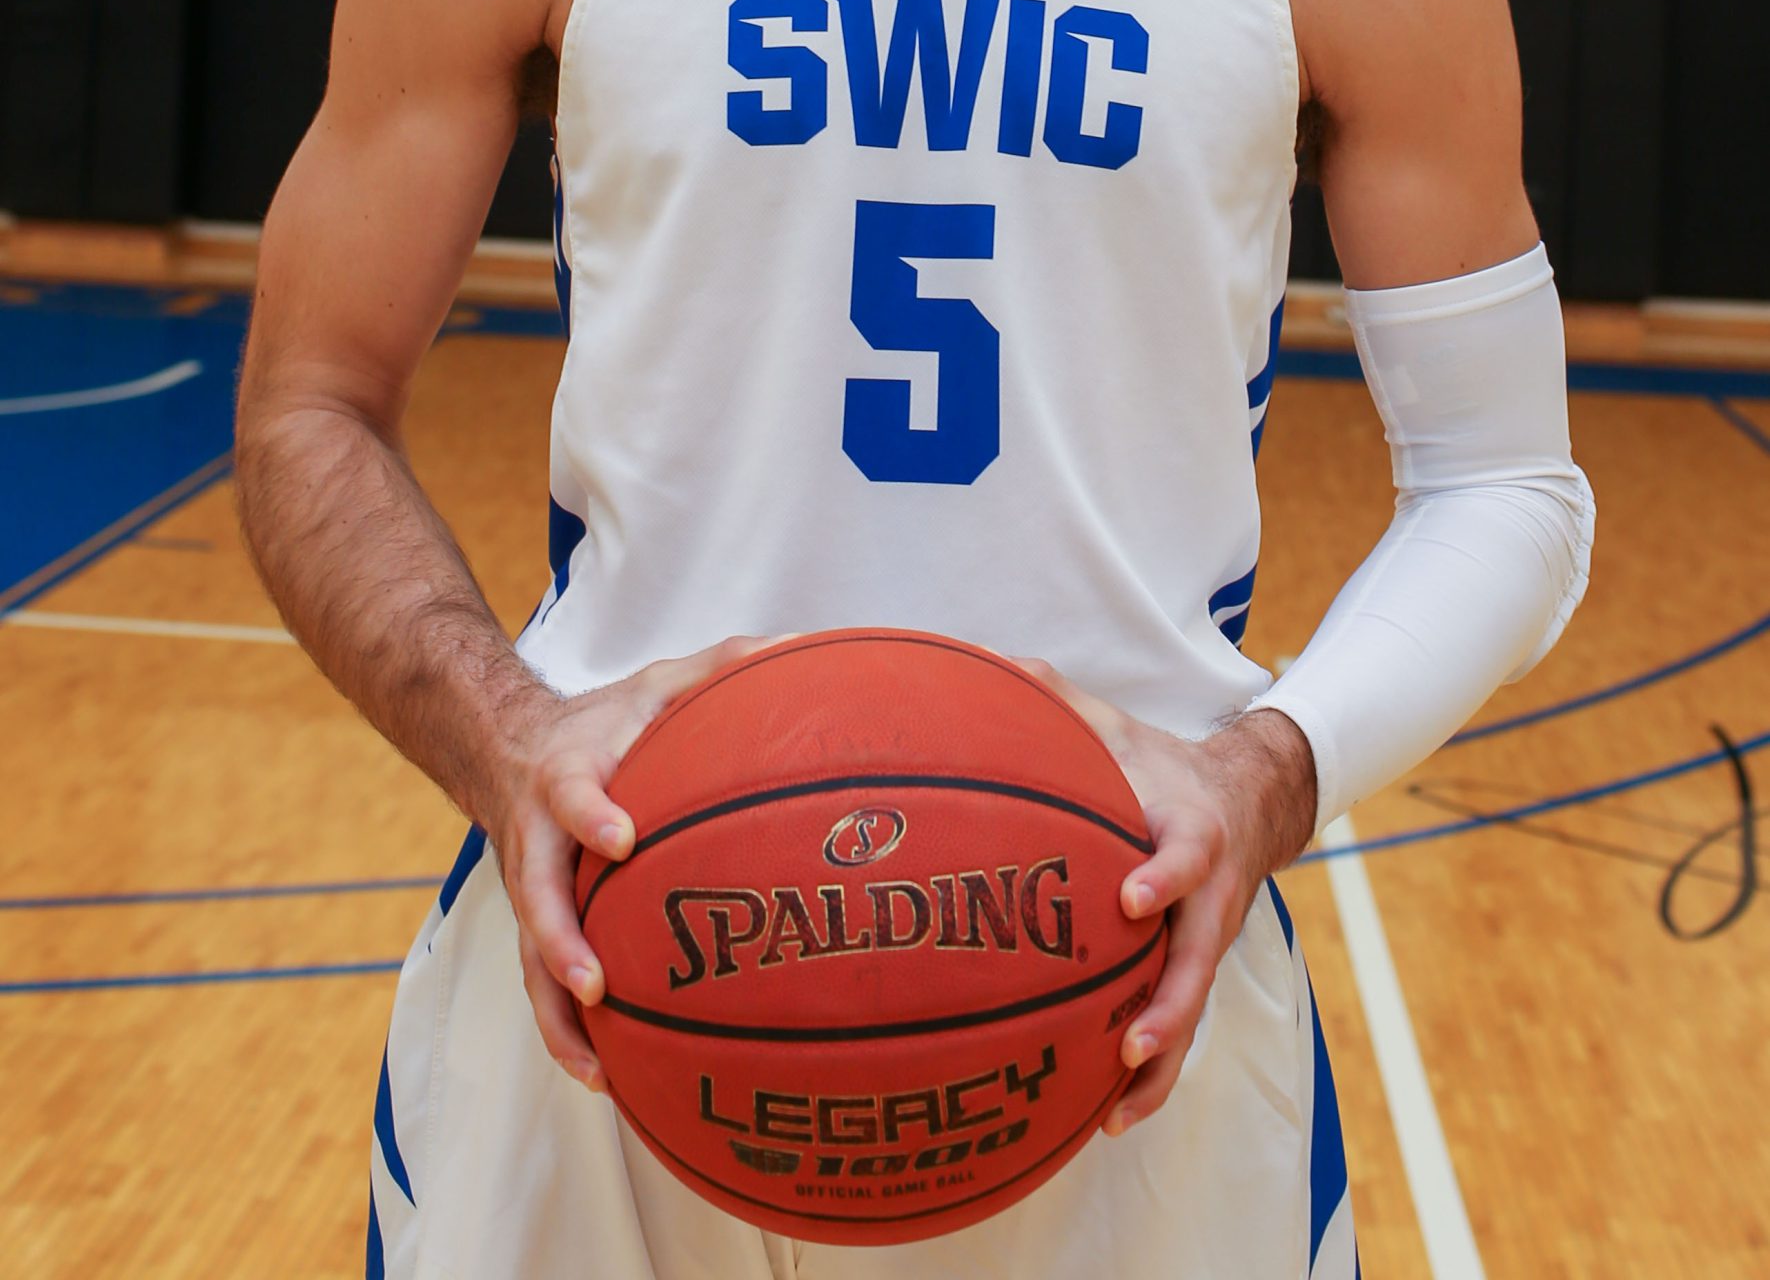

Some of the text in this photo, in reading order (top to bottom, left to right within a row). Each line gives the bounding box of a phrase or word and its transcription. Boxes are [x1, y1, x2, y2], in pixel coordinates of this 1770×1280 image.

[842, 199, 1000, 485] 5
[699, 1044, 1057, 1146] LEGACY
[795, 1170, 976, 1200] OFFICIAL GAME BALL
[815, 1117, 1031, 1177] 1000
